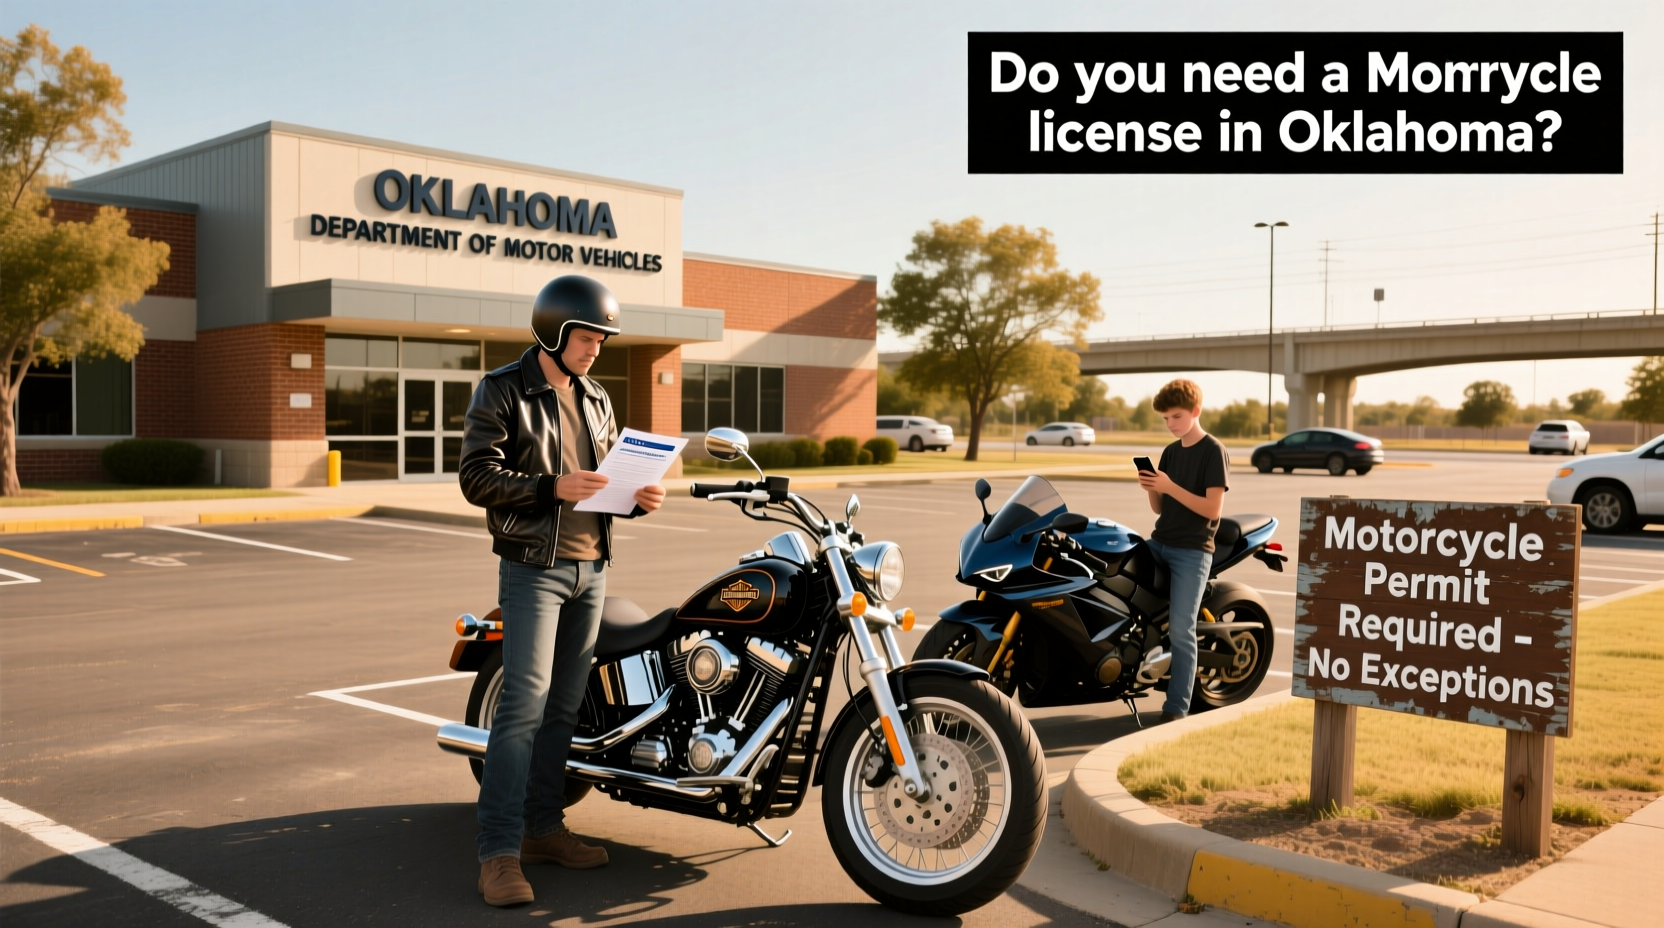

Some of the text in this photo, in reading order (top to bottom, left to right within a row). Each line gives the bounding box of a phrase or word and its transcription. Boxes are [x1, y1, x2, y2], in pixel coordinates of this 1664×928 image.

[373, 169, 617, 239] OKLAHOMA
[310, 214, 663, 273] DEPARTMENT OF MOTOR VEHICLES
[1324, 515, 1544, 568] Motorcycle
[1364, 561, 1490, 605] Permit
[1338, 603, 1502, 653] Required
[1308, 647, 1555, 708] No Exceptions
